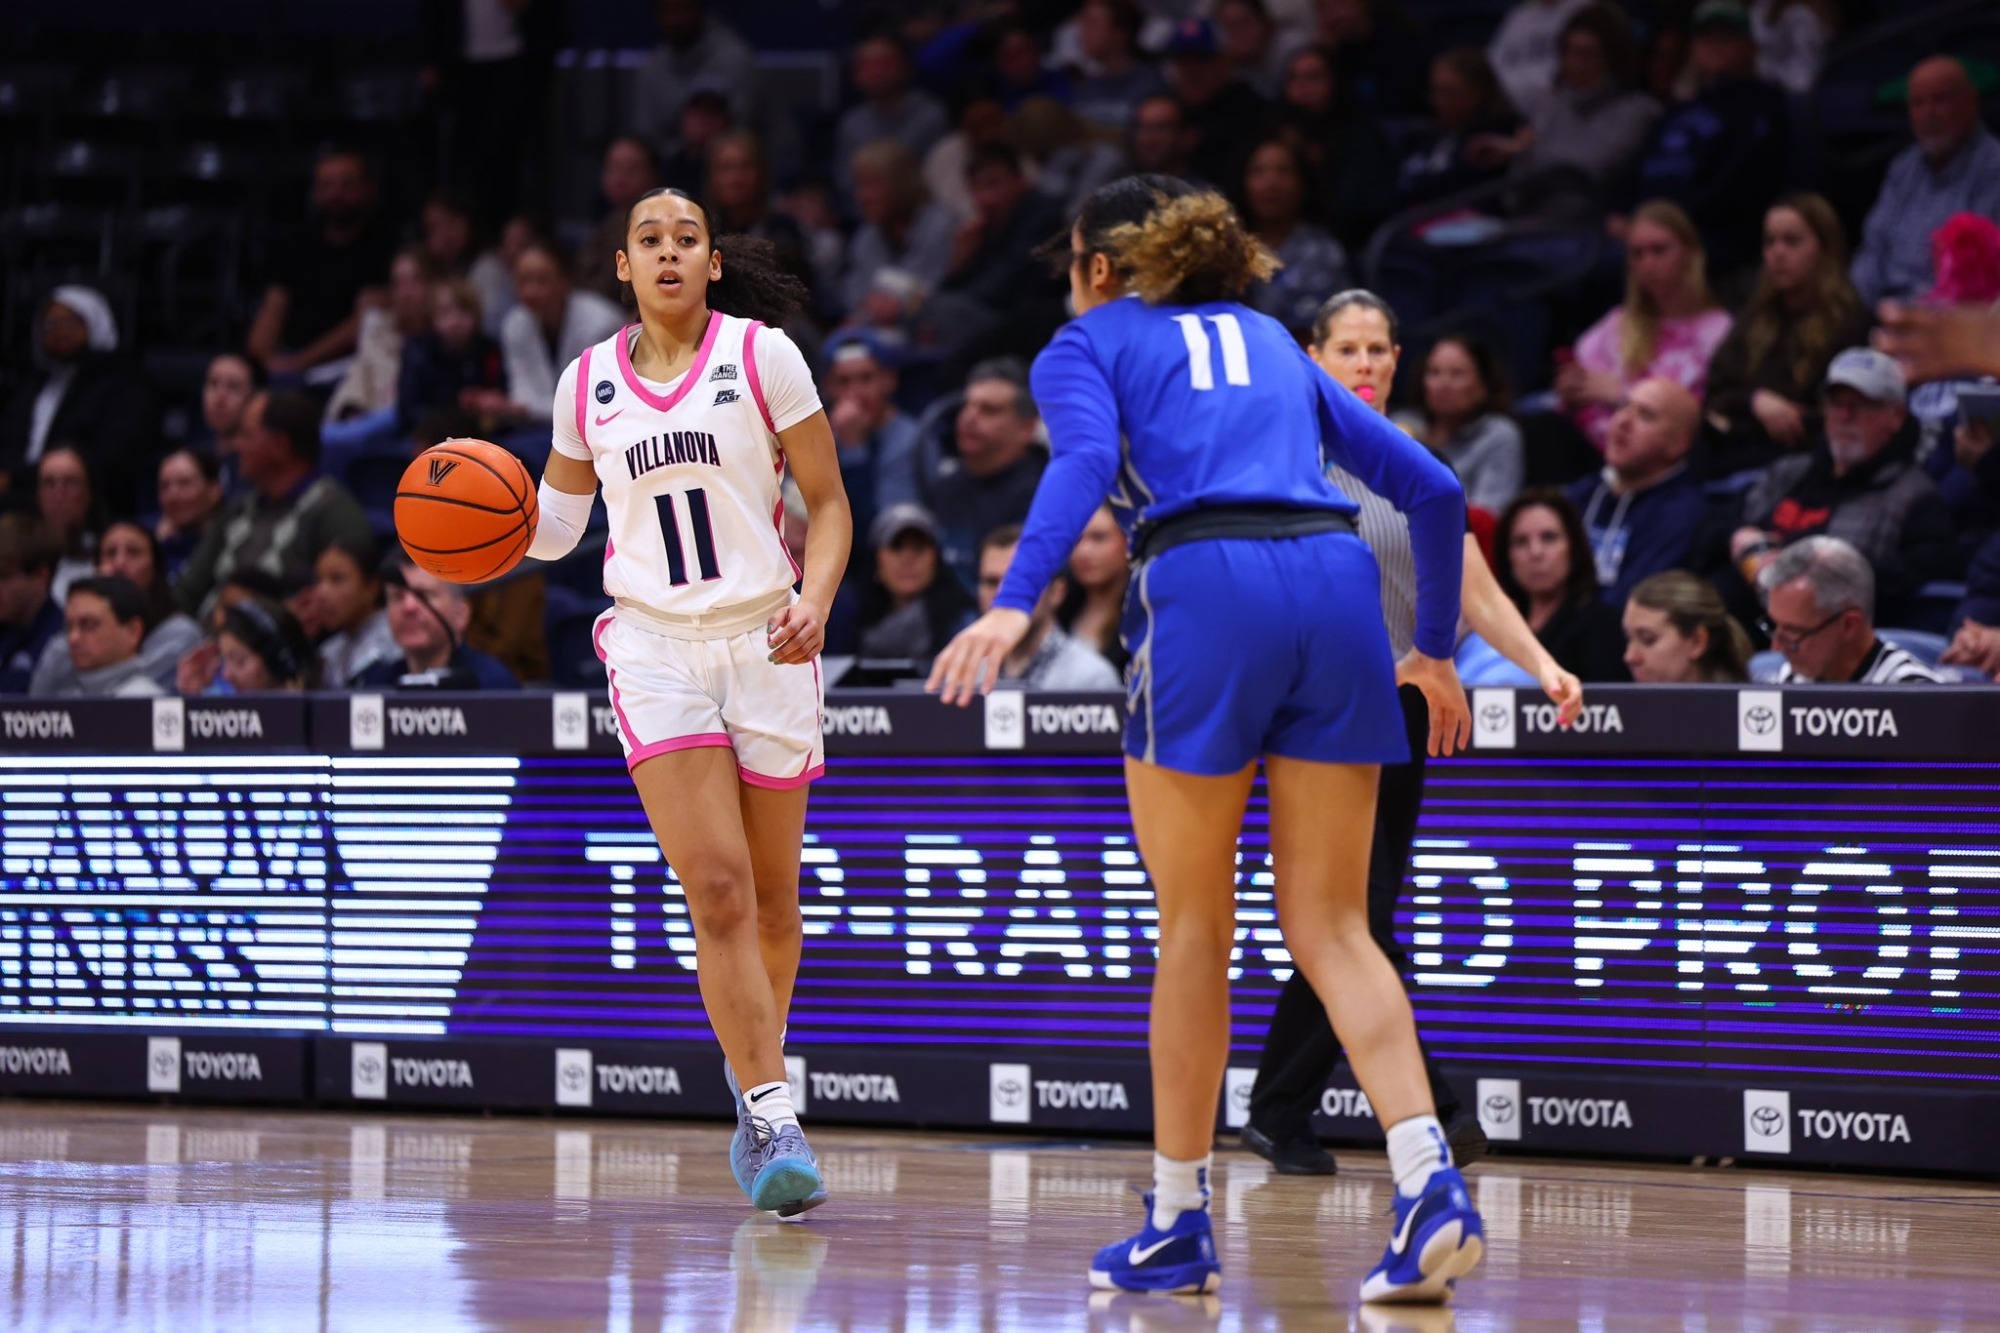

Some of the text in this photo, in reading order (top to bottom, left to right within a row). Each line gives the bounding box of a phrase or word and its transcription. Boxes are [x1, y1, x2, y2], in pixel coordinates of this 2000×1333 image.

[1170, 313, 1251, 390] 11
[714, 394, 741, 403] EAST
[624, 431, 722, 481] VILLANOVA
[426, 458, 461, 487] V
[653, 487, 722, 588] 11
[3, 711, 74, 738] TOYOTA
[188, 709, 263, 738] TOYOTA
[388, 706, 467, 736] TOYOTA
[822, 706, 892, 735] OYOTA
[1028, 704, 1120, 734] TOYOTA
[1521, 704, 1623, 733] TOOTA
[1789, 707, 1898, 738] TOYOTA
[0, 1046, 71, 1075] TOYOTA
[185, 1051, 261, 1080] TOYOTA
[391, 1058, 473, 1088] TOYOTA
[596, 1064, 681, 1095] TOYOTA
[809, 1072, 899, 1102] TOYOTA
[1034, 1080, 1129, 1111] TOYOTA
[1527, 1097, 1632, 1128] TOYOTA
[1797, 1109, 1911, 1143] TOYOTA
